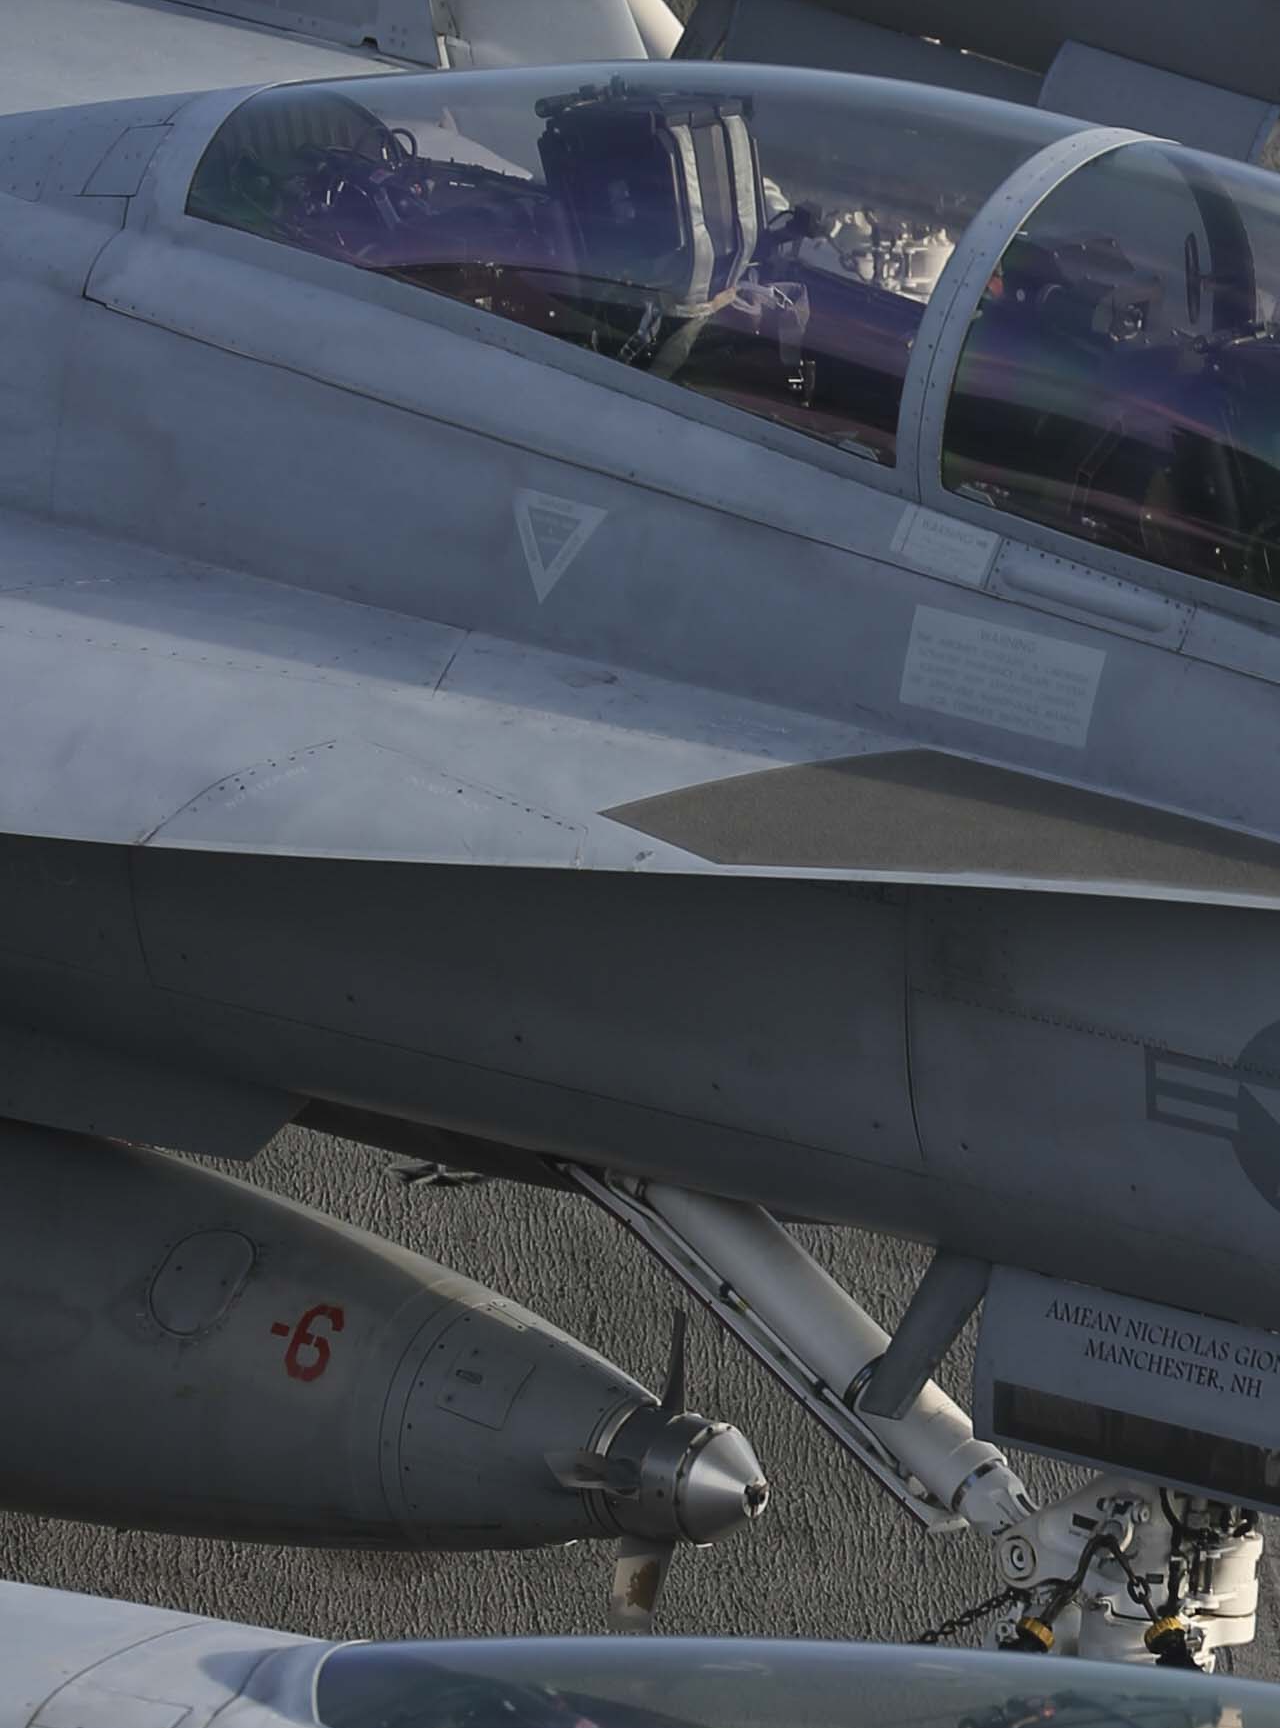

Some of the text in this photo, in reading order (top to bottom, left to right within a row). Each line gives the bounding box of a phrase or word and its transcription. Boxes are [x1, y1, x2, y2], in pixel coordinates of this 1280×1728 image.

[1045, 1299, 1121, 1335] AMEAN
[1125, 1320, 1231, 1362] NICHOLAS
[1084, 1338, 1263, 1399] MANCHESTER, NH
